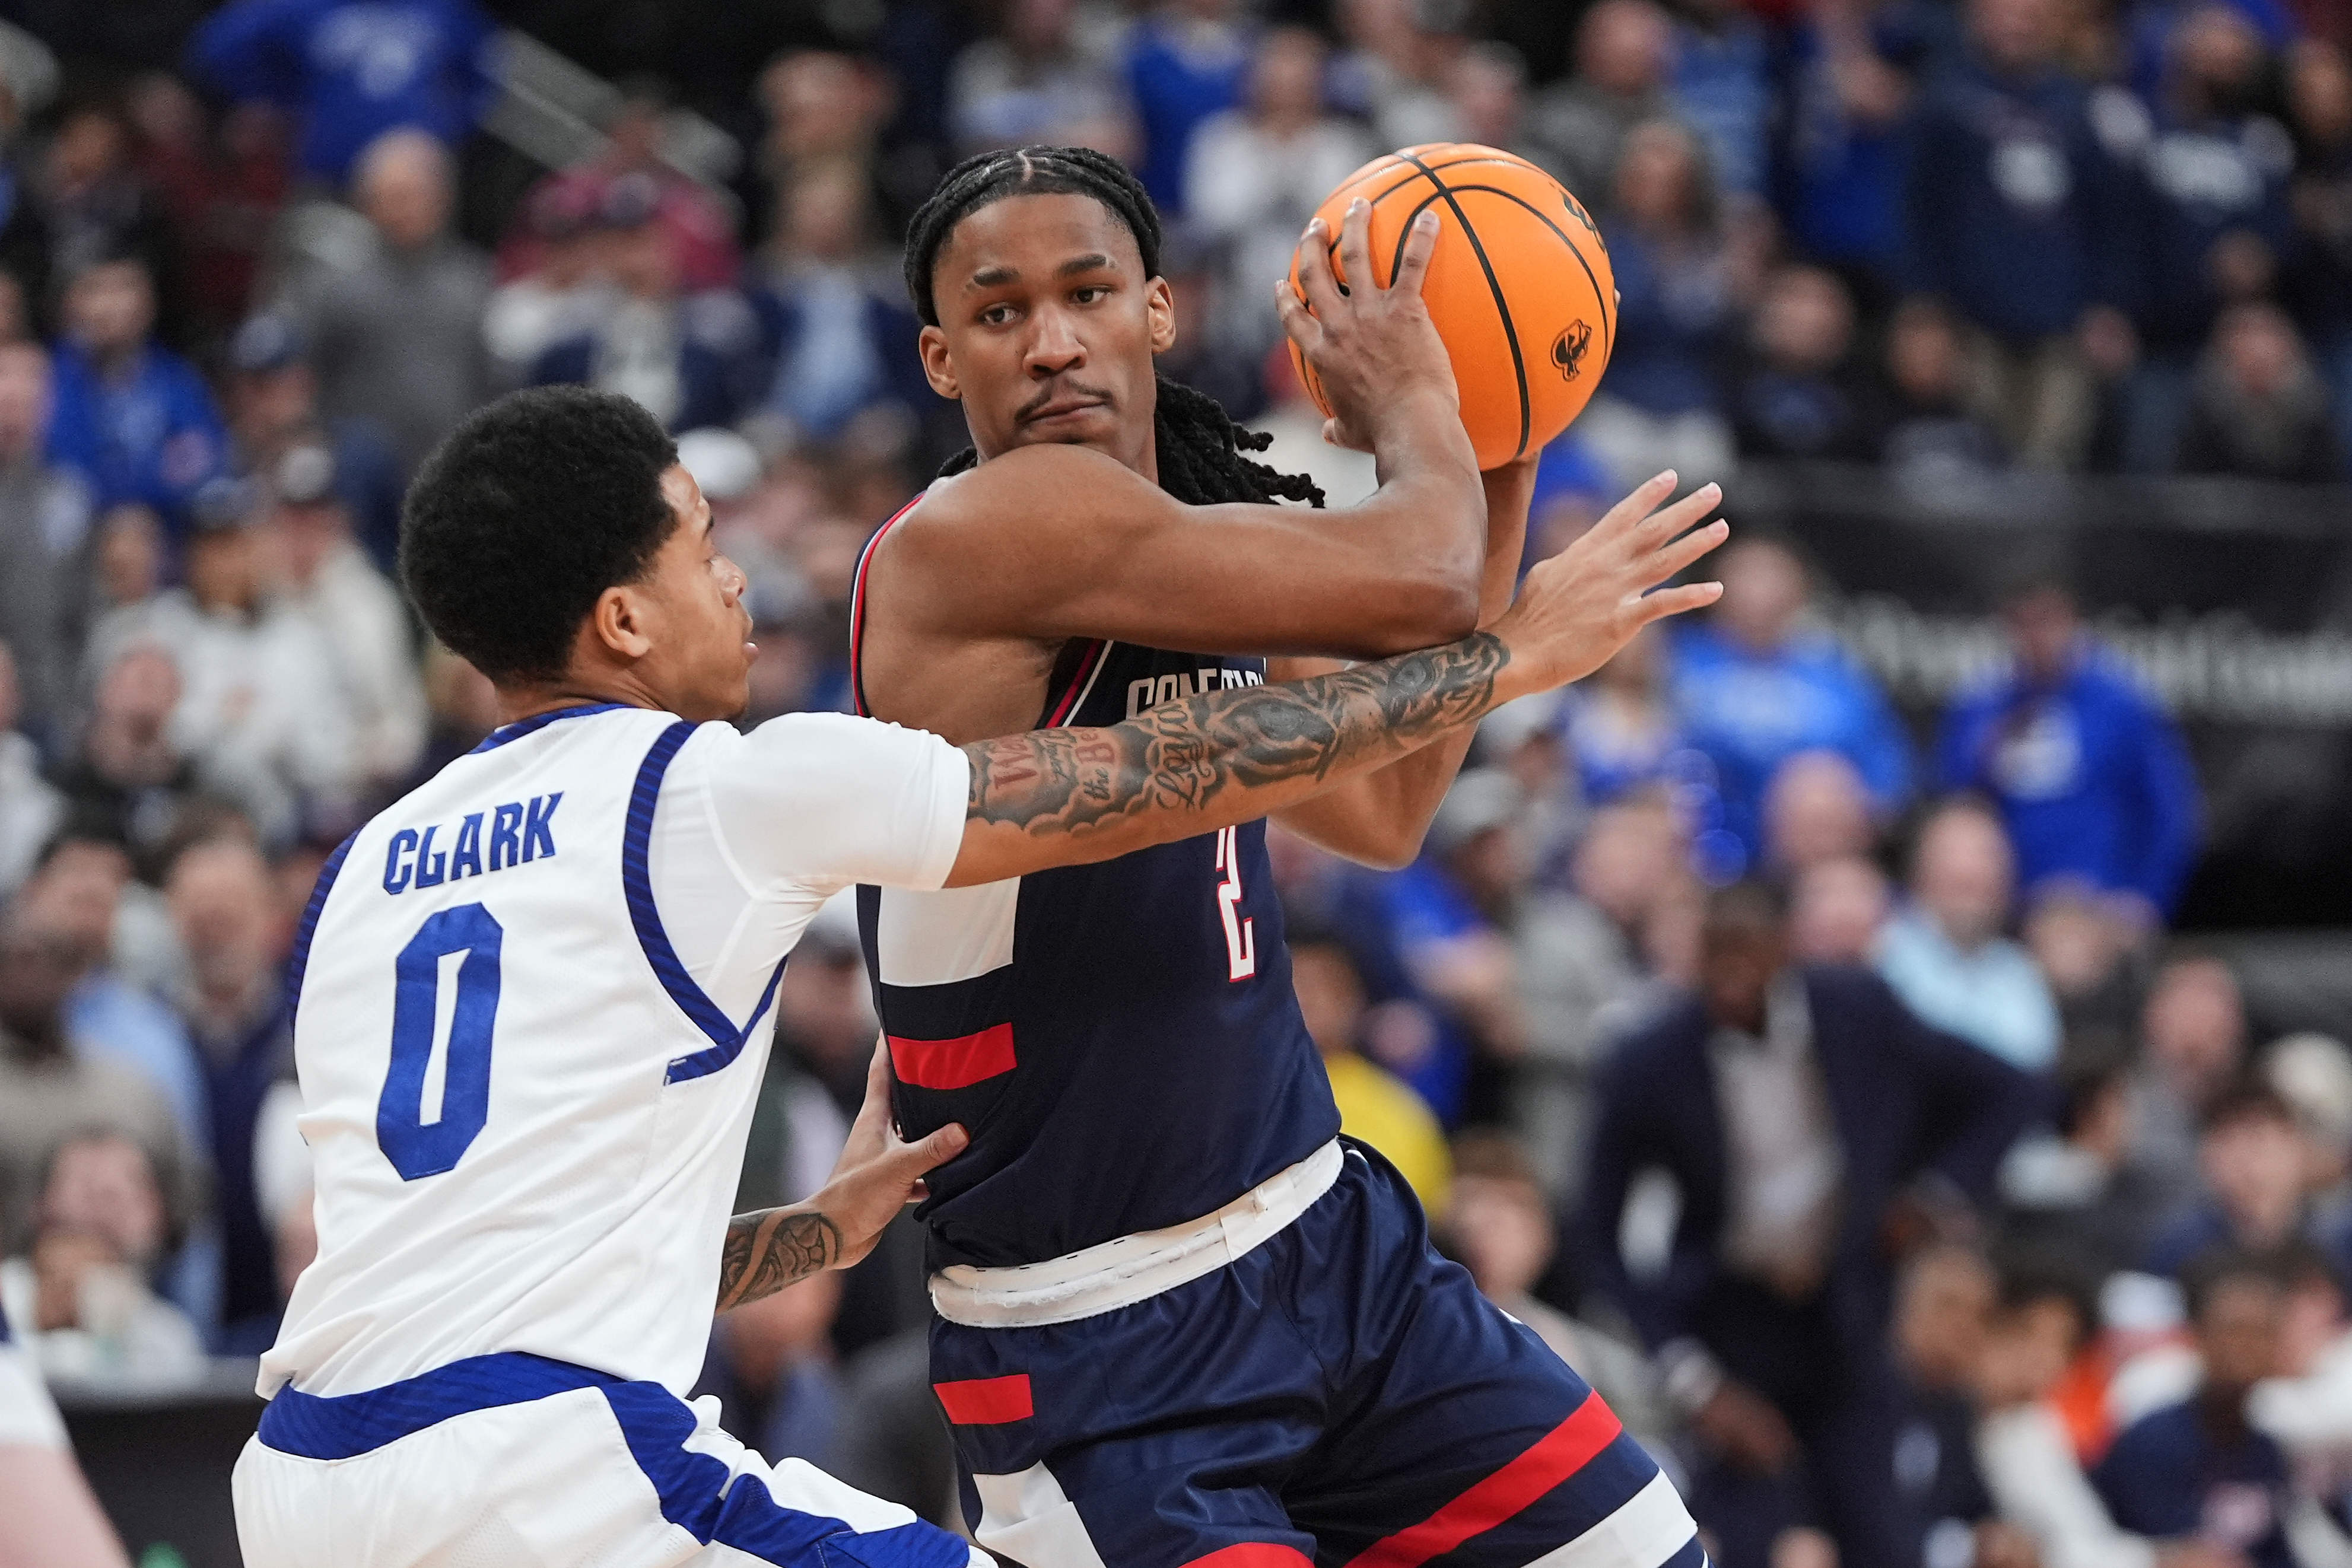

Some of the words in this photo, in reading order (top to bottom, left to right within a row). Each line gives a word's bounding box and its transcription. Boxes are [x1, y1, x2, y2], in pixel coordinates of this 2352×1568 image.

[382, 791, 564, 895] CLARK
[1215, 824, 1256, 982] 2
[376, 901, 504, 1182] 0
